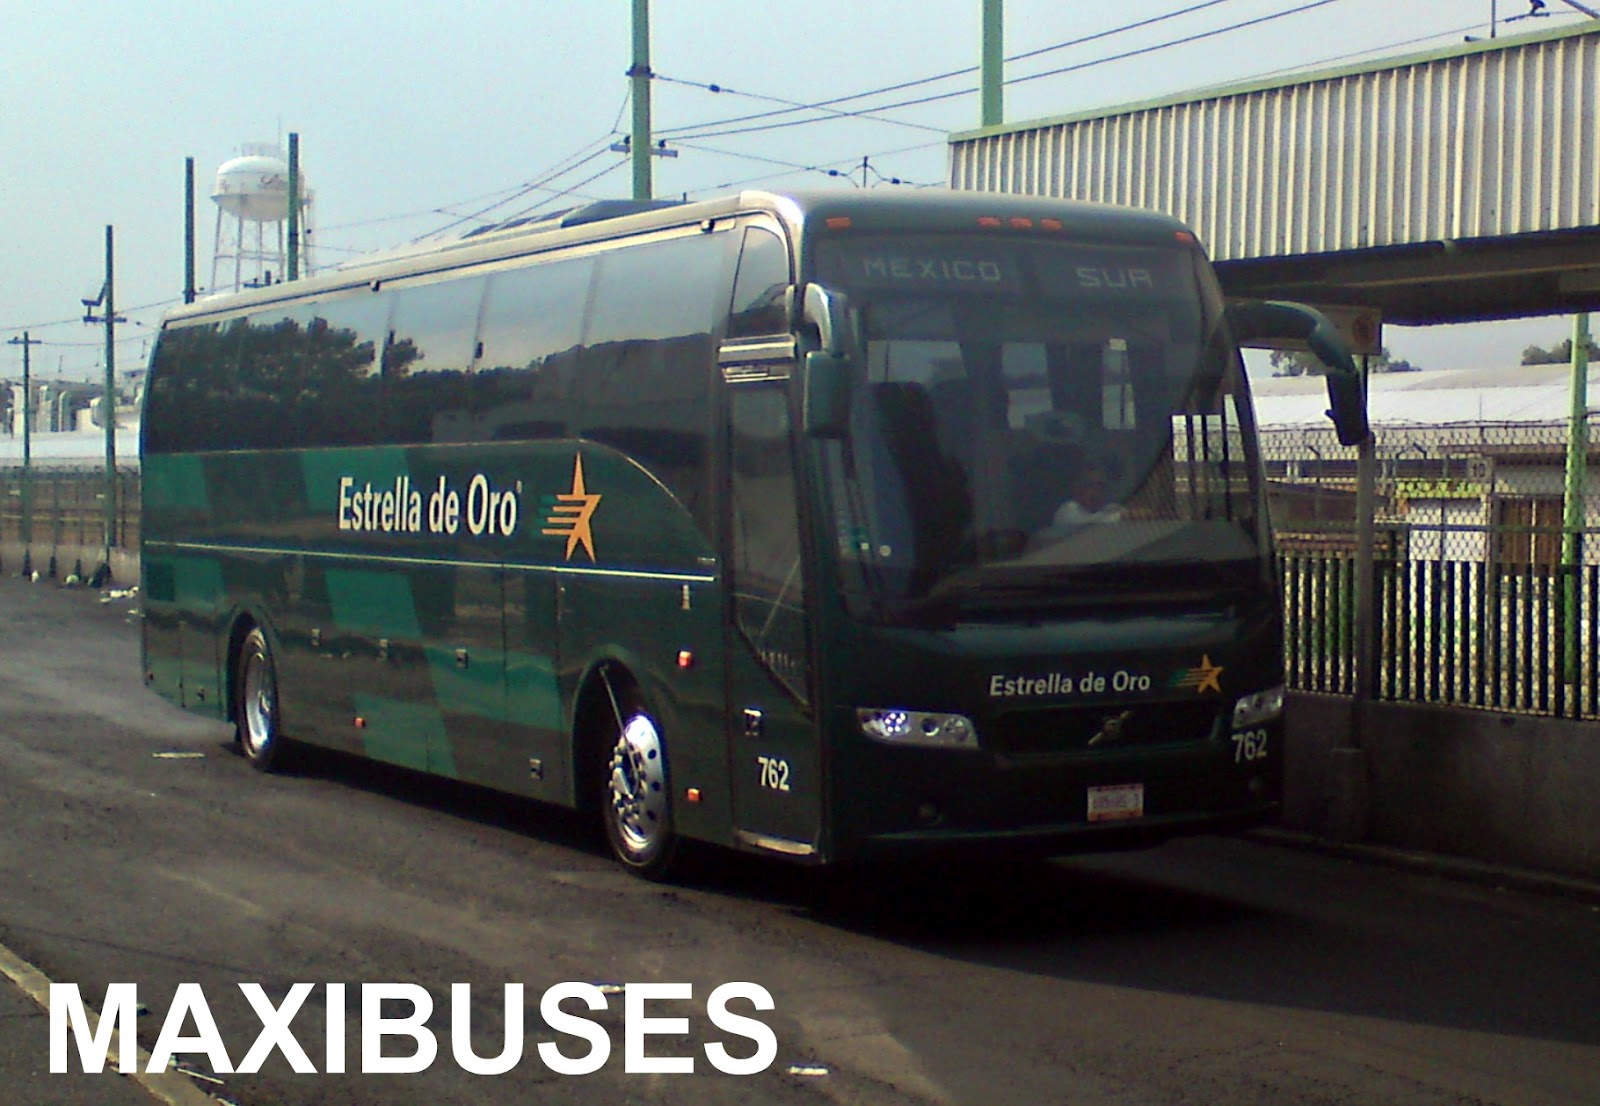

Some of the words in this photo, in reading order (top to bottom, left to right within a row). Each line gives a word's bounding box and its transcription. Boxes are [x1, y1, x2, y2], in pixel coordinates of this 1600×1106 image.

[863, 258, 1000, 282] MEXICO
[1075, 266, 1153, 289] SUR
[338, 475, 421, 533] Estrella
[429, 475, 459, 535] de
[467, 473, 517, 537] Oro
[989, 673, 1073, 697] Estrella
[1079, 671, 1106, 693] de
[1112, 670, 1151, 692] Oro
[1231, 728, 1268, 764] 762
[757, 756, 791, 792] 762
